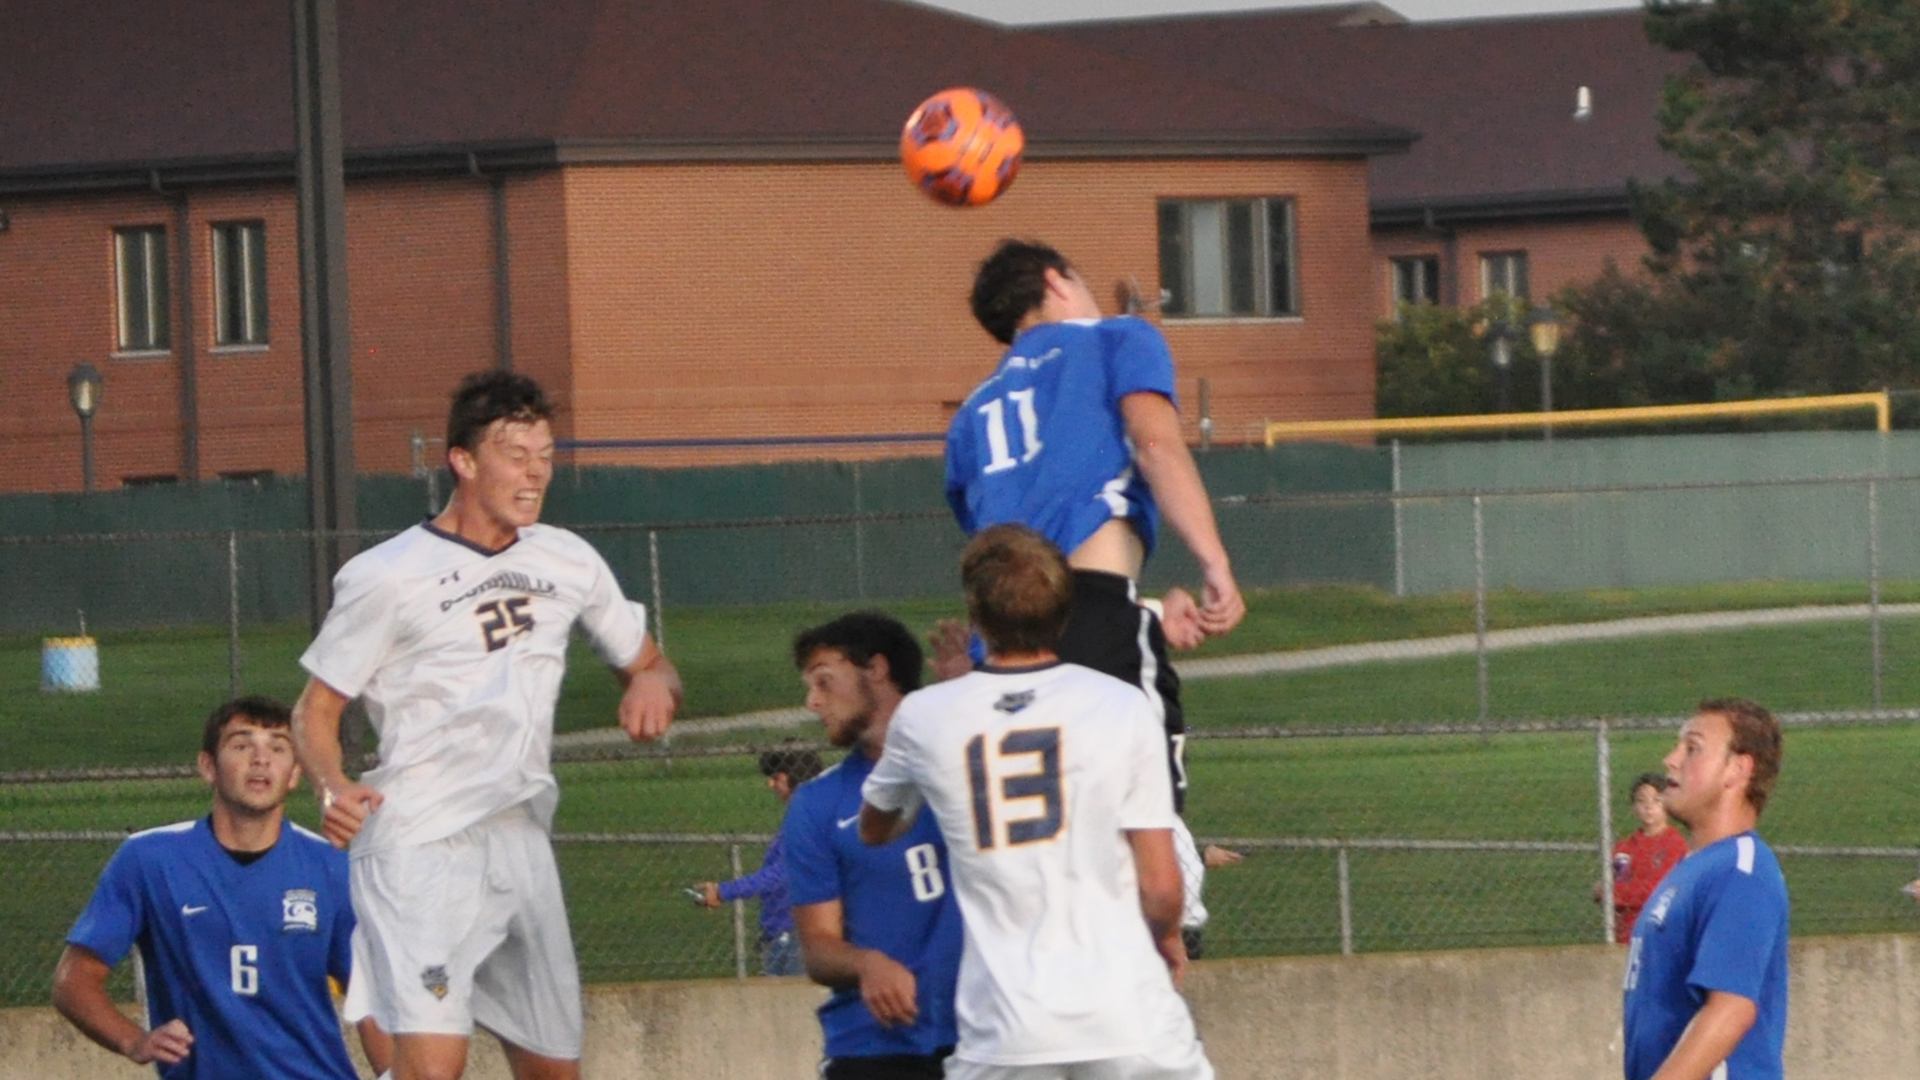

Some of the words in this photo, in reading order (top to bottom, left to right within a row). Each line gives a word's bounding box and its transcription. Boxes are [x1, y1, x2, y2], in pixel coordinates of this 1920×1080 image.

[978, 387, 1043, 474] 11
[475, 595, 536, 653] 25
[964, 725, 1064, 852] 13
[904, 842, 945, 901] 8
[230, 944, 258, 994] 6
